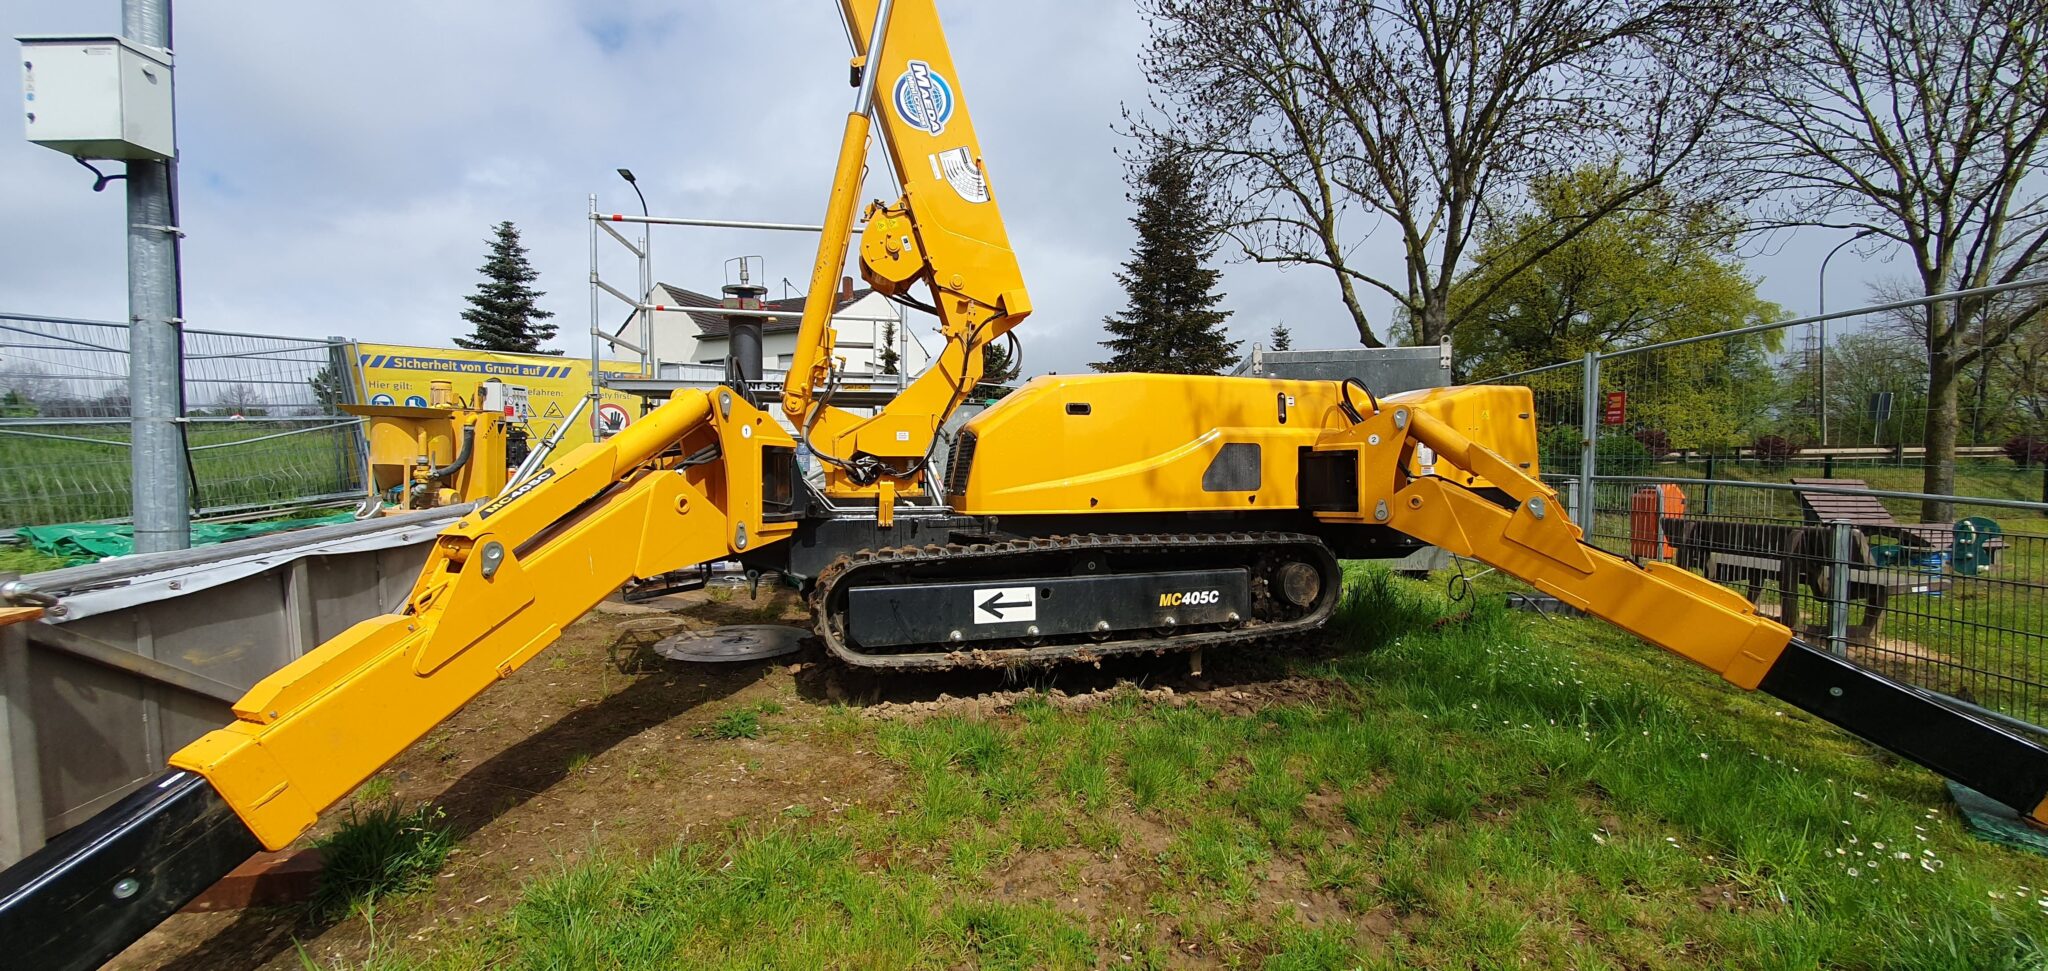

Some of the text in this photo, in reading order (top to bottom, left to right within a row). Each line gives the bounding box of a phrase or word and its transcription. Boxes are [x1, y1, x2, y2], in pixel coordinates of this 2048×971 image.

[911, 63, 942, 134] MAEDA
[394, 357, 541, 376] Sicherheit von Grund auf
[368, 380, 413, 391] Hier gilt:
[527, 388, 564, 397] efahren:
[484, 472, 551, 513] MC405C
[1159, 590, 1220, 607] MC405C
